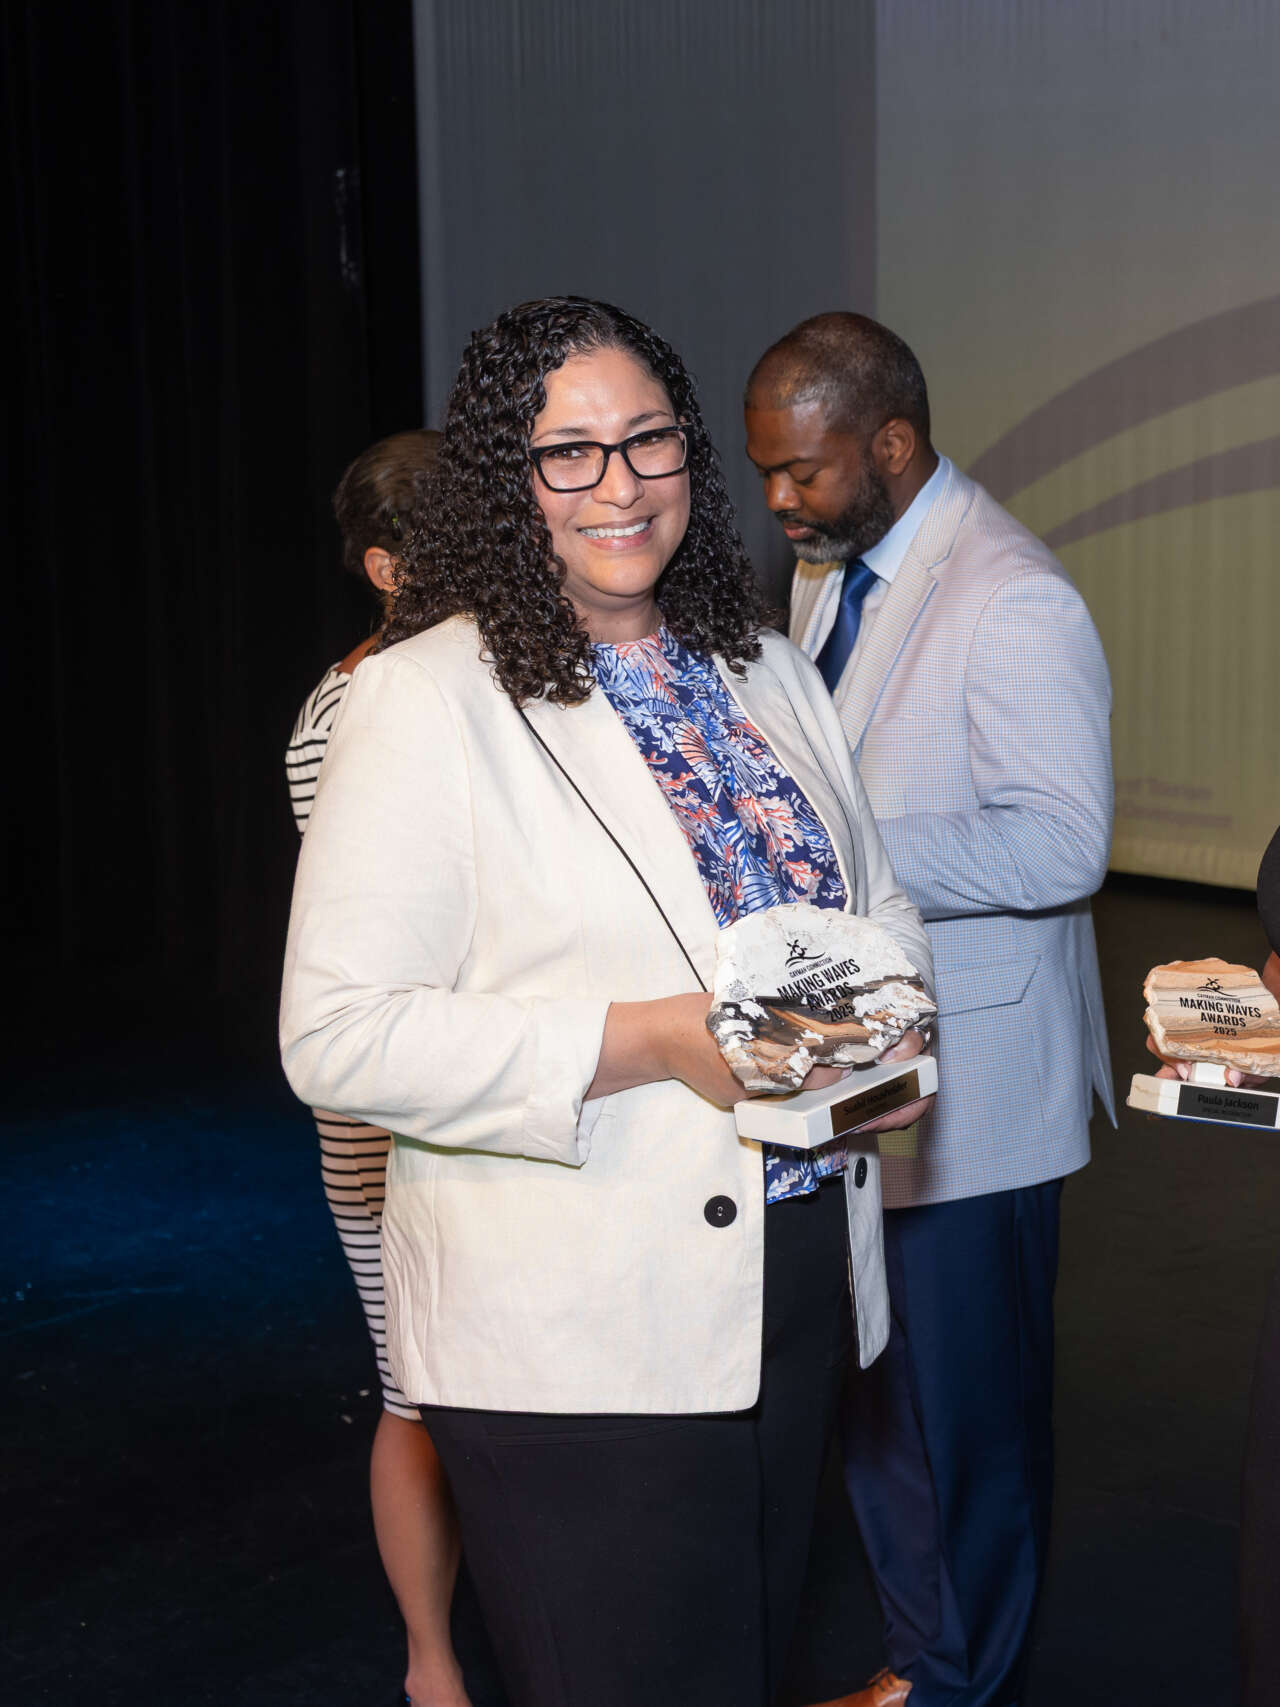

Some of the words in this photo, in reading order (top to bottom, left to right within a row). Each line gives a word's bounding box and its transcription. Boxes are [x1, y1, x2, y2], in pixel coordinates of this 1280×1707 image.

[777, 973, 825, 1001] MAKING
[820, 958, 861, 984] WAVES
[807, 982, 854, 1011] AWARDS
[827, 1002, 855, 1022] 2025
[1179, 997, 1224, 1013] MAKING
[1225, 1003, 1261, 1018] WAVES
[1200, 1012, 1246, 1027] AWARDS
[1213, 1026, 1237, 1036] 2025
